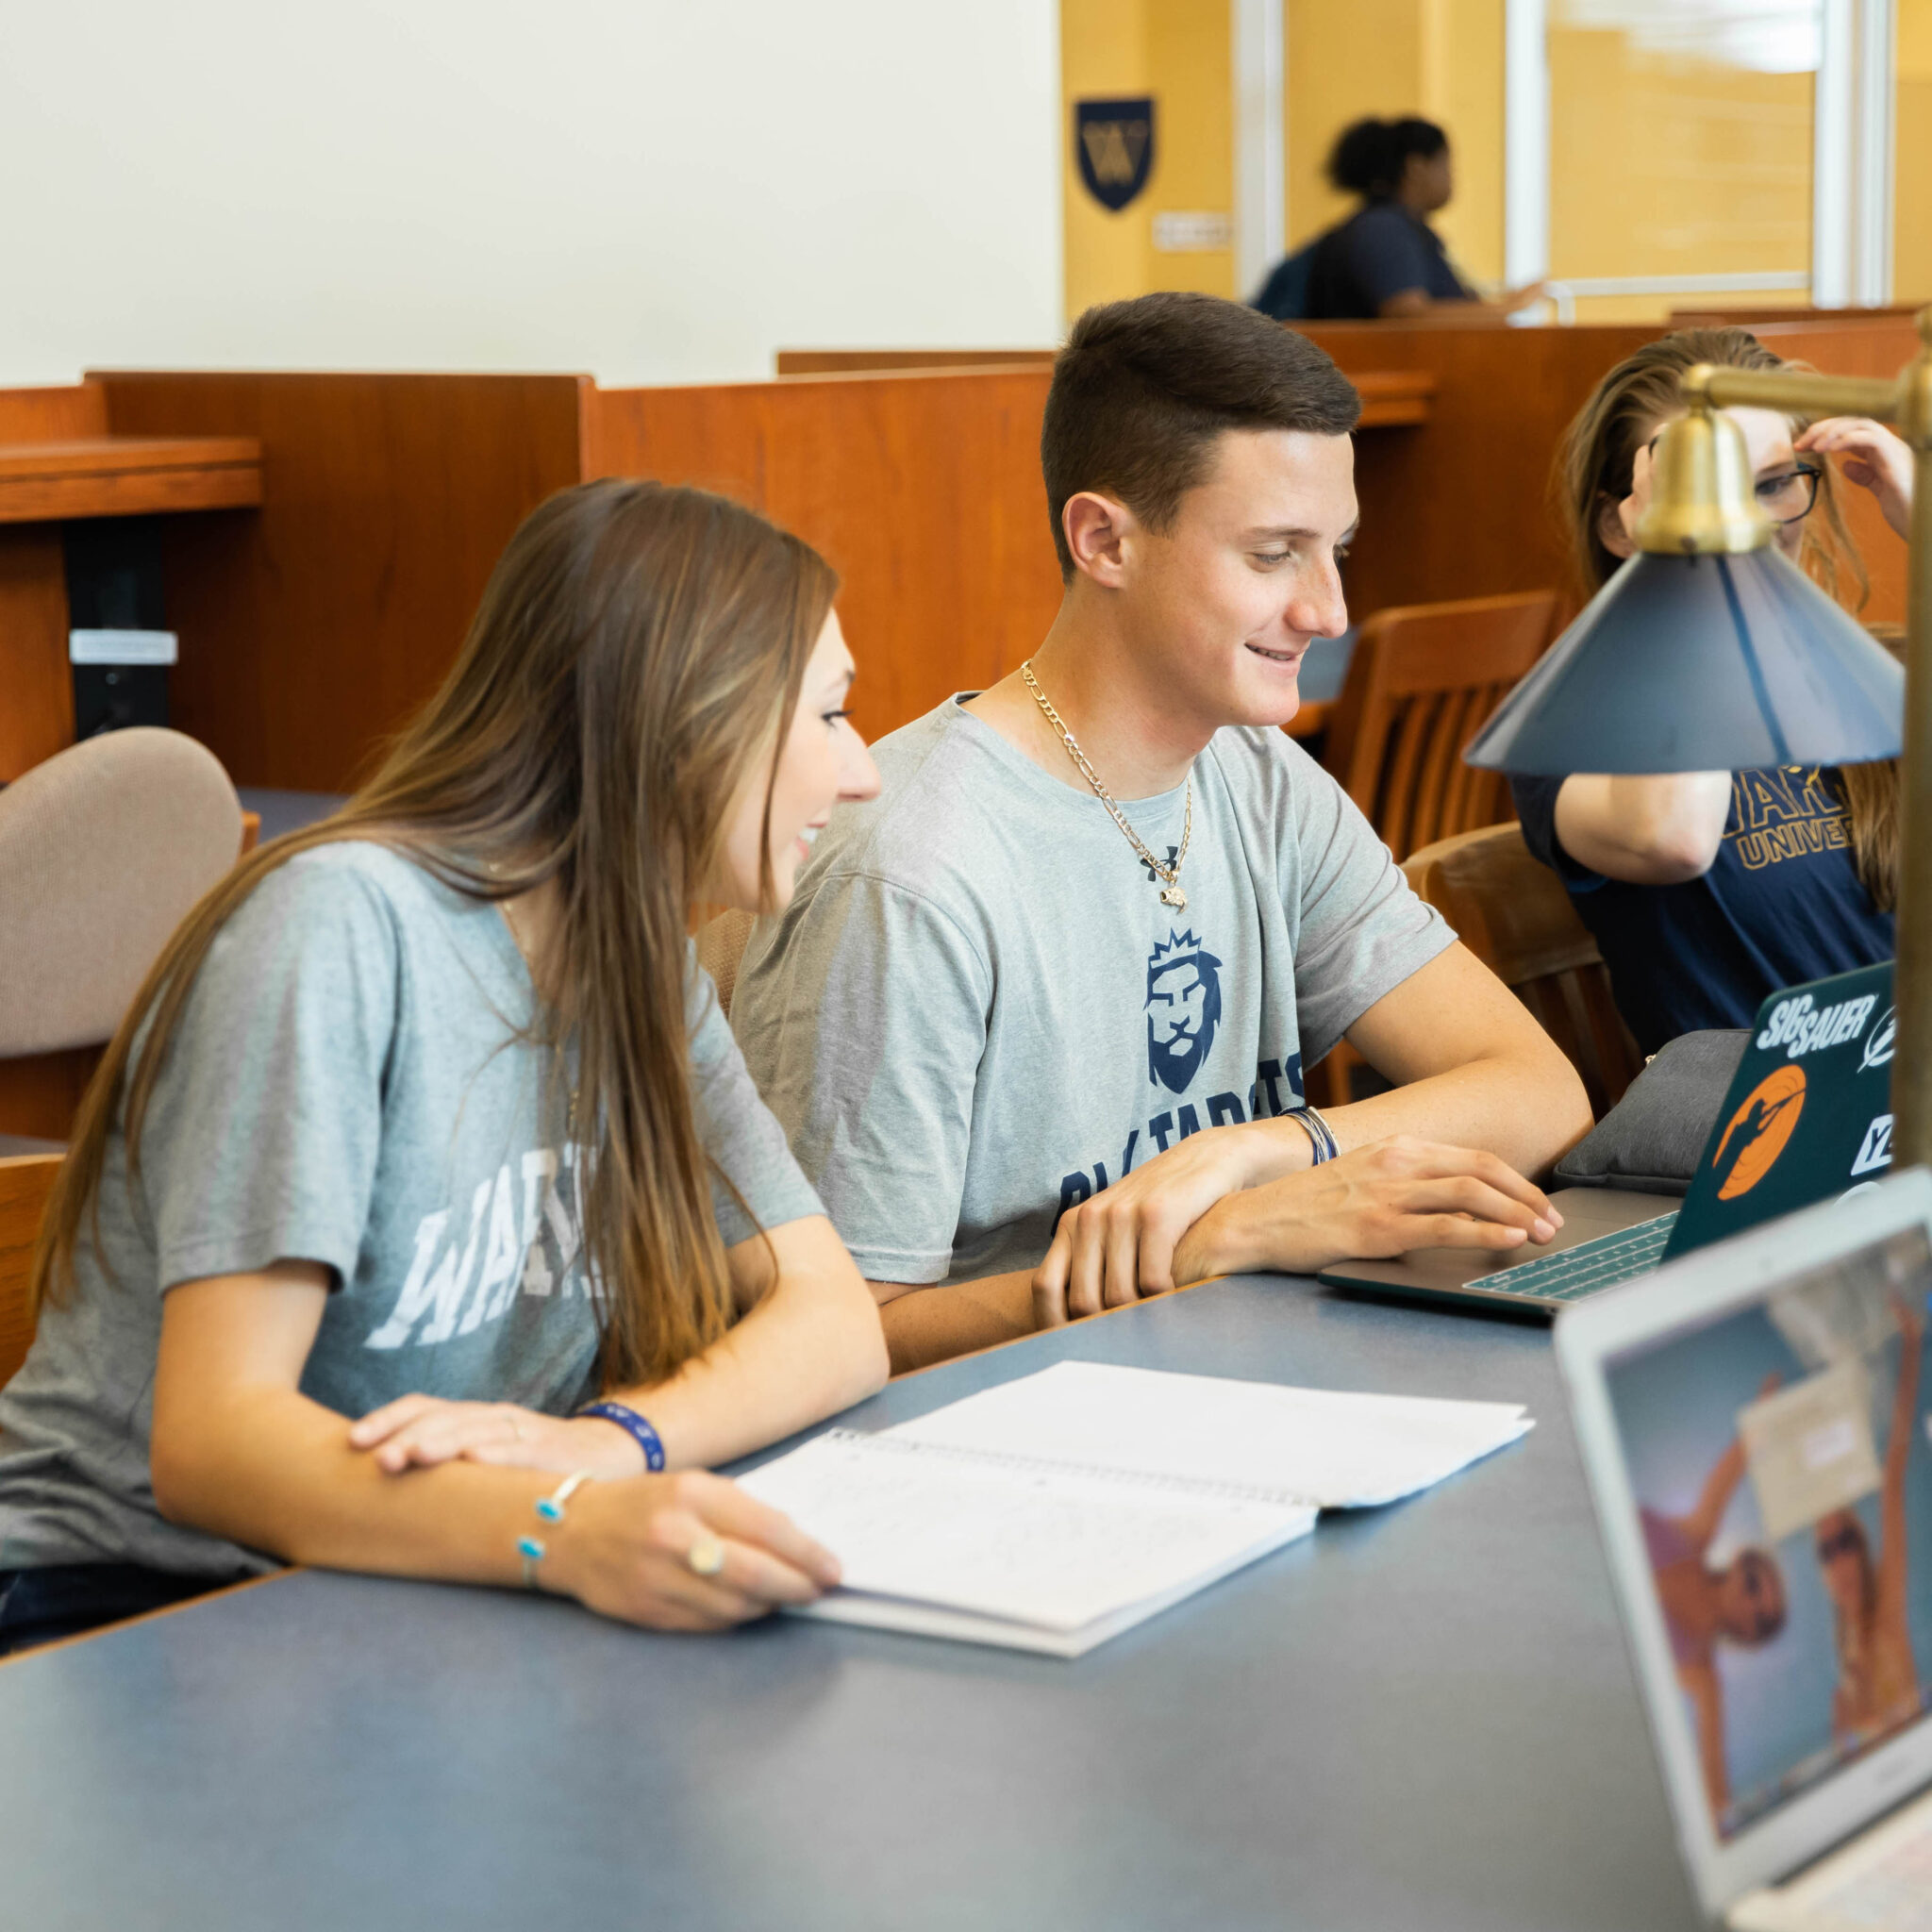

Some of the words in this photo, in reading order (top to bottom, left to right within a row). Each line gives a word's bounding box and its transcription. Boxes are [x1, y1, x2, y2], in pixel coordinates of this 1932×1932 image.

[1737, 814, 1853, 870] UNIVE
[1756, 993, 1814, 1050] SIG
[1787, 993, 1876, 1058] SAUER
